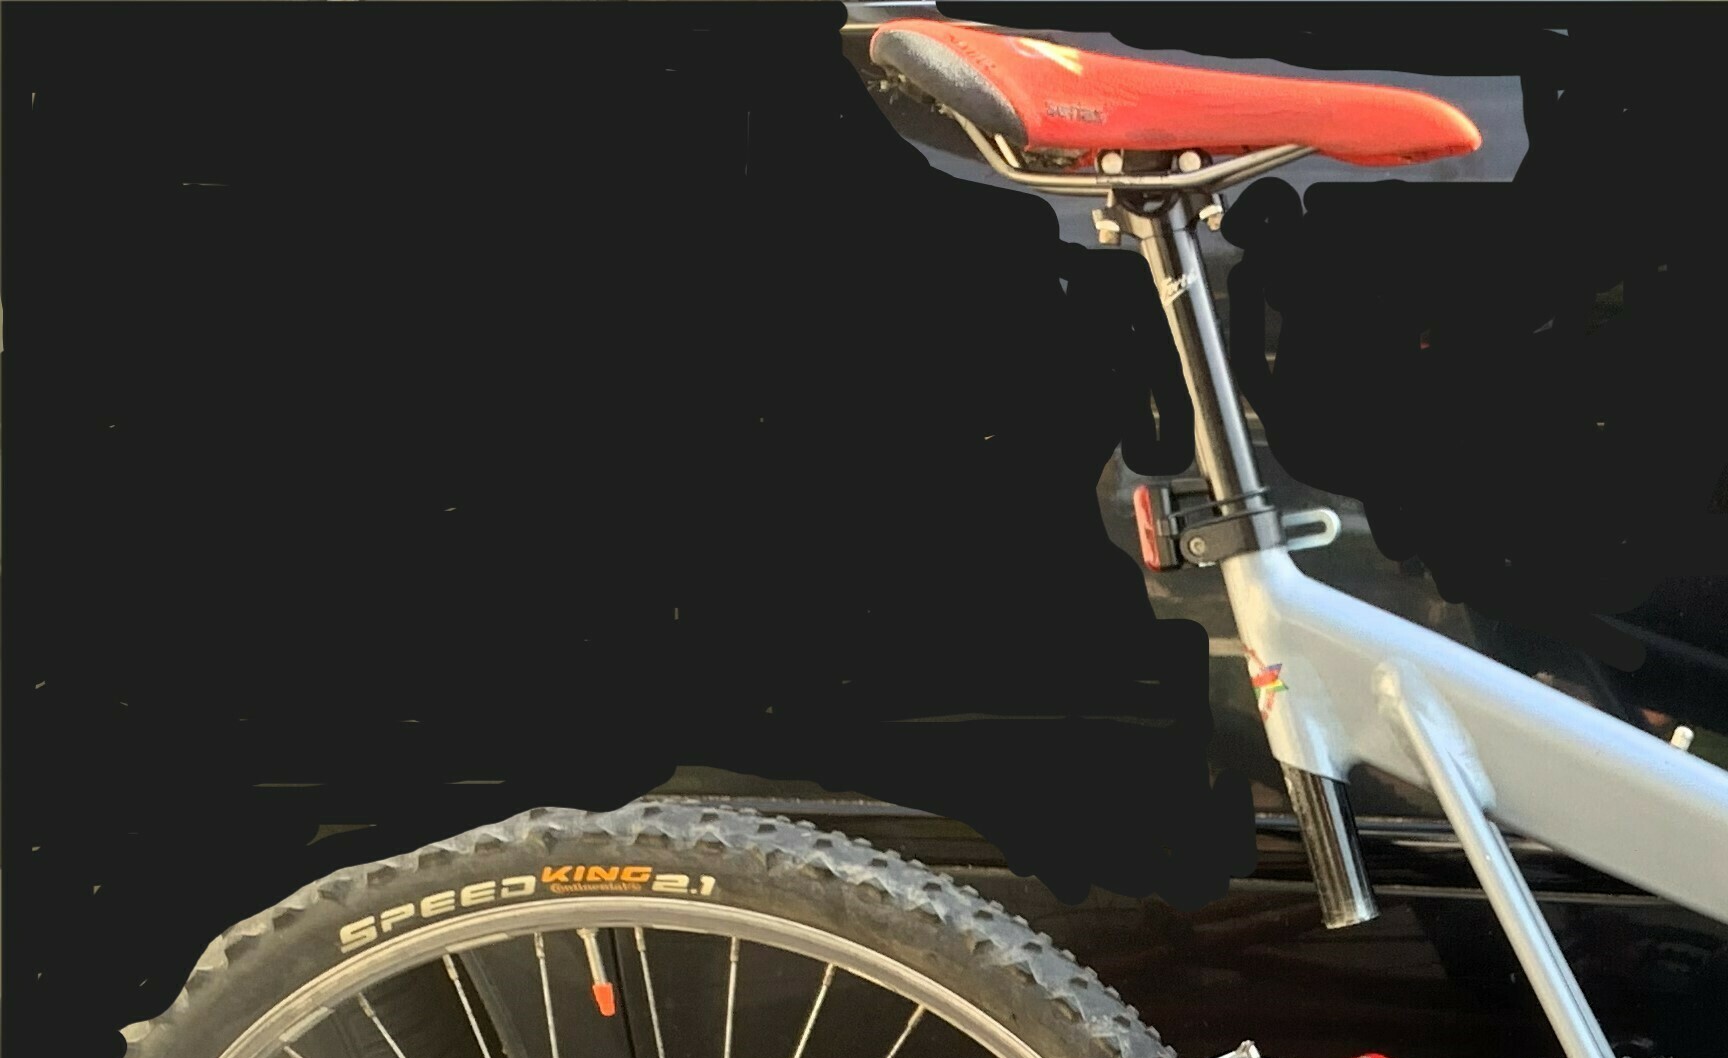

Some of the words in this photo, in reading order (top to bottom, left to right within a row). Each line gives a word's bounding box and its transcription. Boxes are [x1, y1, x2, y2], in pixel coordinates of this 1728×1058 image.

[340, 875, 536, 953] SPEED
[541, 865, 652, 883] KING
[652, 874, 716, 896] 2.1
